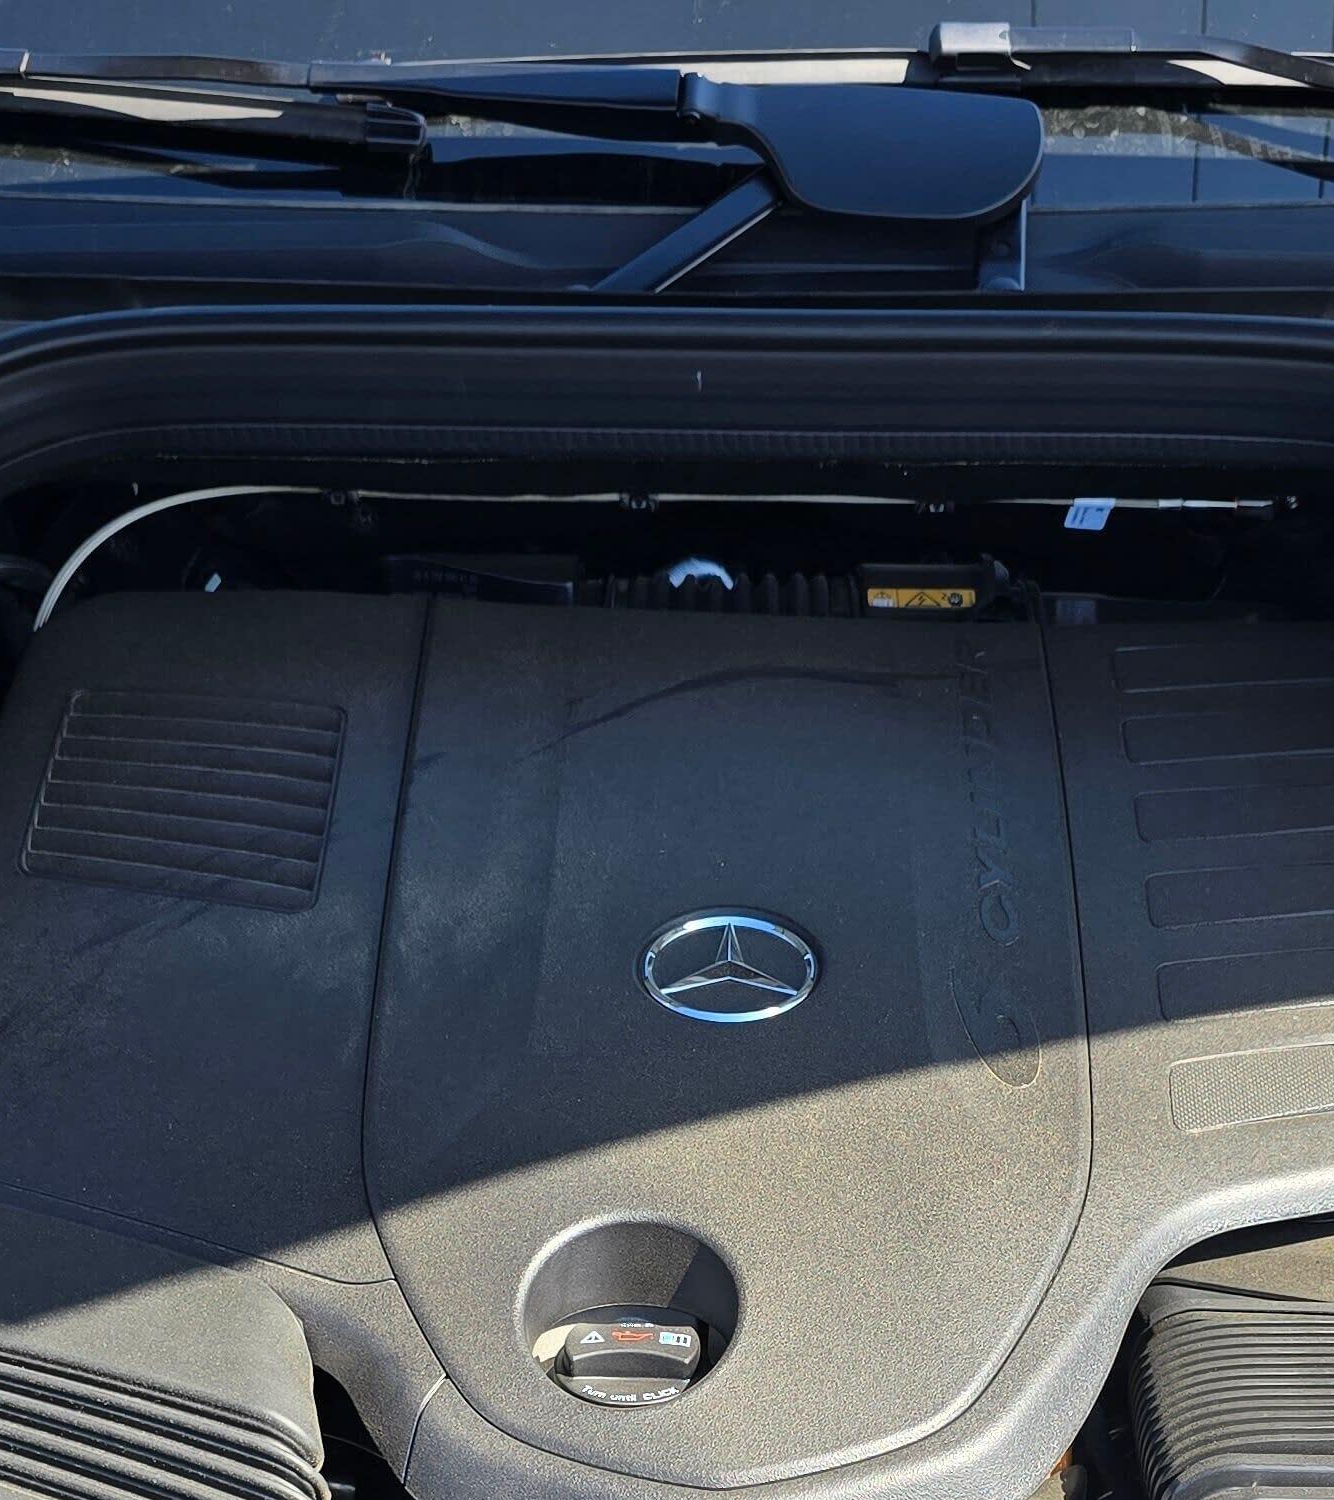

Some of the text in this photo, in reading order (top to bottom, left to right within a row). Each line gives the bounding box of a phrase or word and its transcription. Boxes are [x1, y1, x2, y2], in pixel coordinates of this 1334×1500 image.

[581, 1384, 680, 1402] Turn until CLICK
